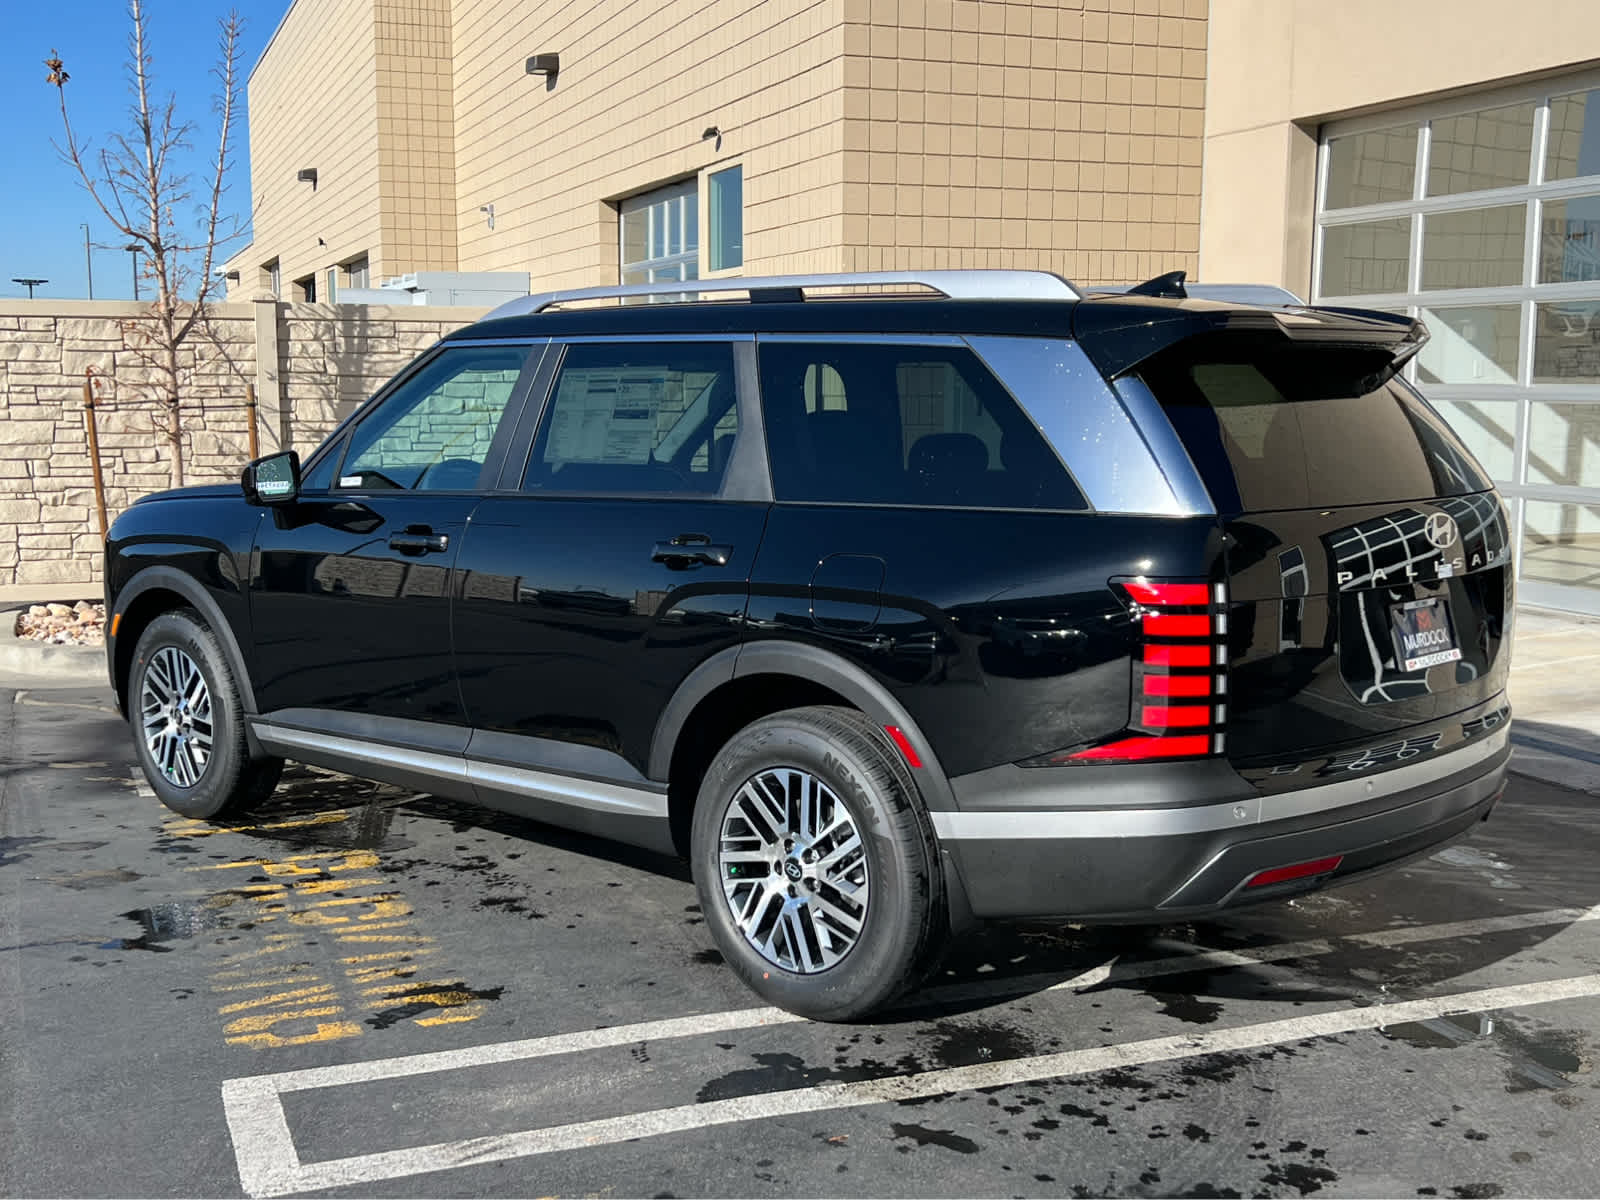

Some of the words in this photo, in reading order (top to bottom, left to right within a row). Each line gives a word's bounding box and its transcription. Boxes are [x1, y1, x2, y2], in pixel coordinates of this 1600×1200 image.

[1337, 548, 1505, 585] PALISADE
[1404, 629, 1449, 650] MURDOCK
[823, 752, 880, 825] NEXEN
